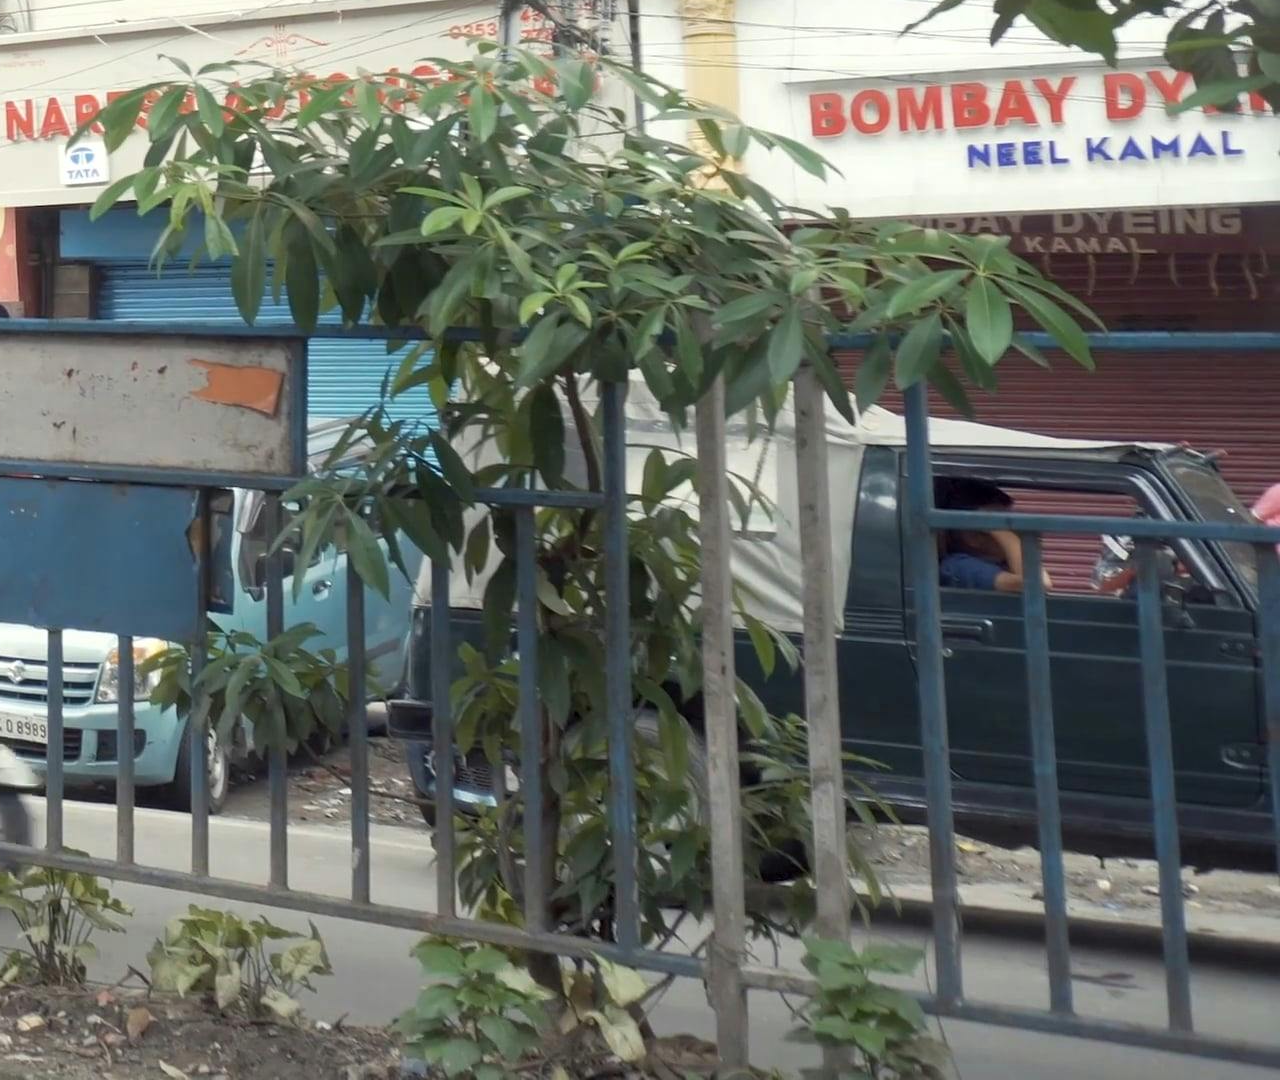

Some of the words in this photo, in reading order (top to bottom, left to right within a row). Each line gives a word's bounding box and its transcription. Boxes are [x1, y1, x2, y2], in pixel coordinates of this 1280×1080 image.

[809, 76, 1077, 138] BOMBAY
[967, 140, 1069, 169] NEEL
[1086, 130, 1244, 162] KAMAL
[67, 168, 100, 180] TATA
[1024, 234, 1157, 255] KAMAL
[16, 720, 46, 738] 8989
